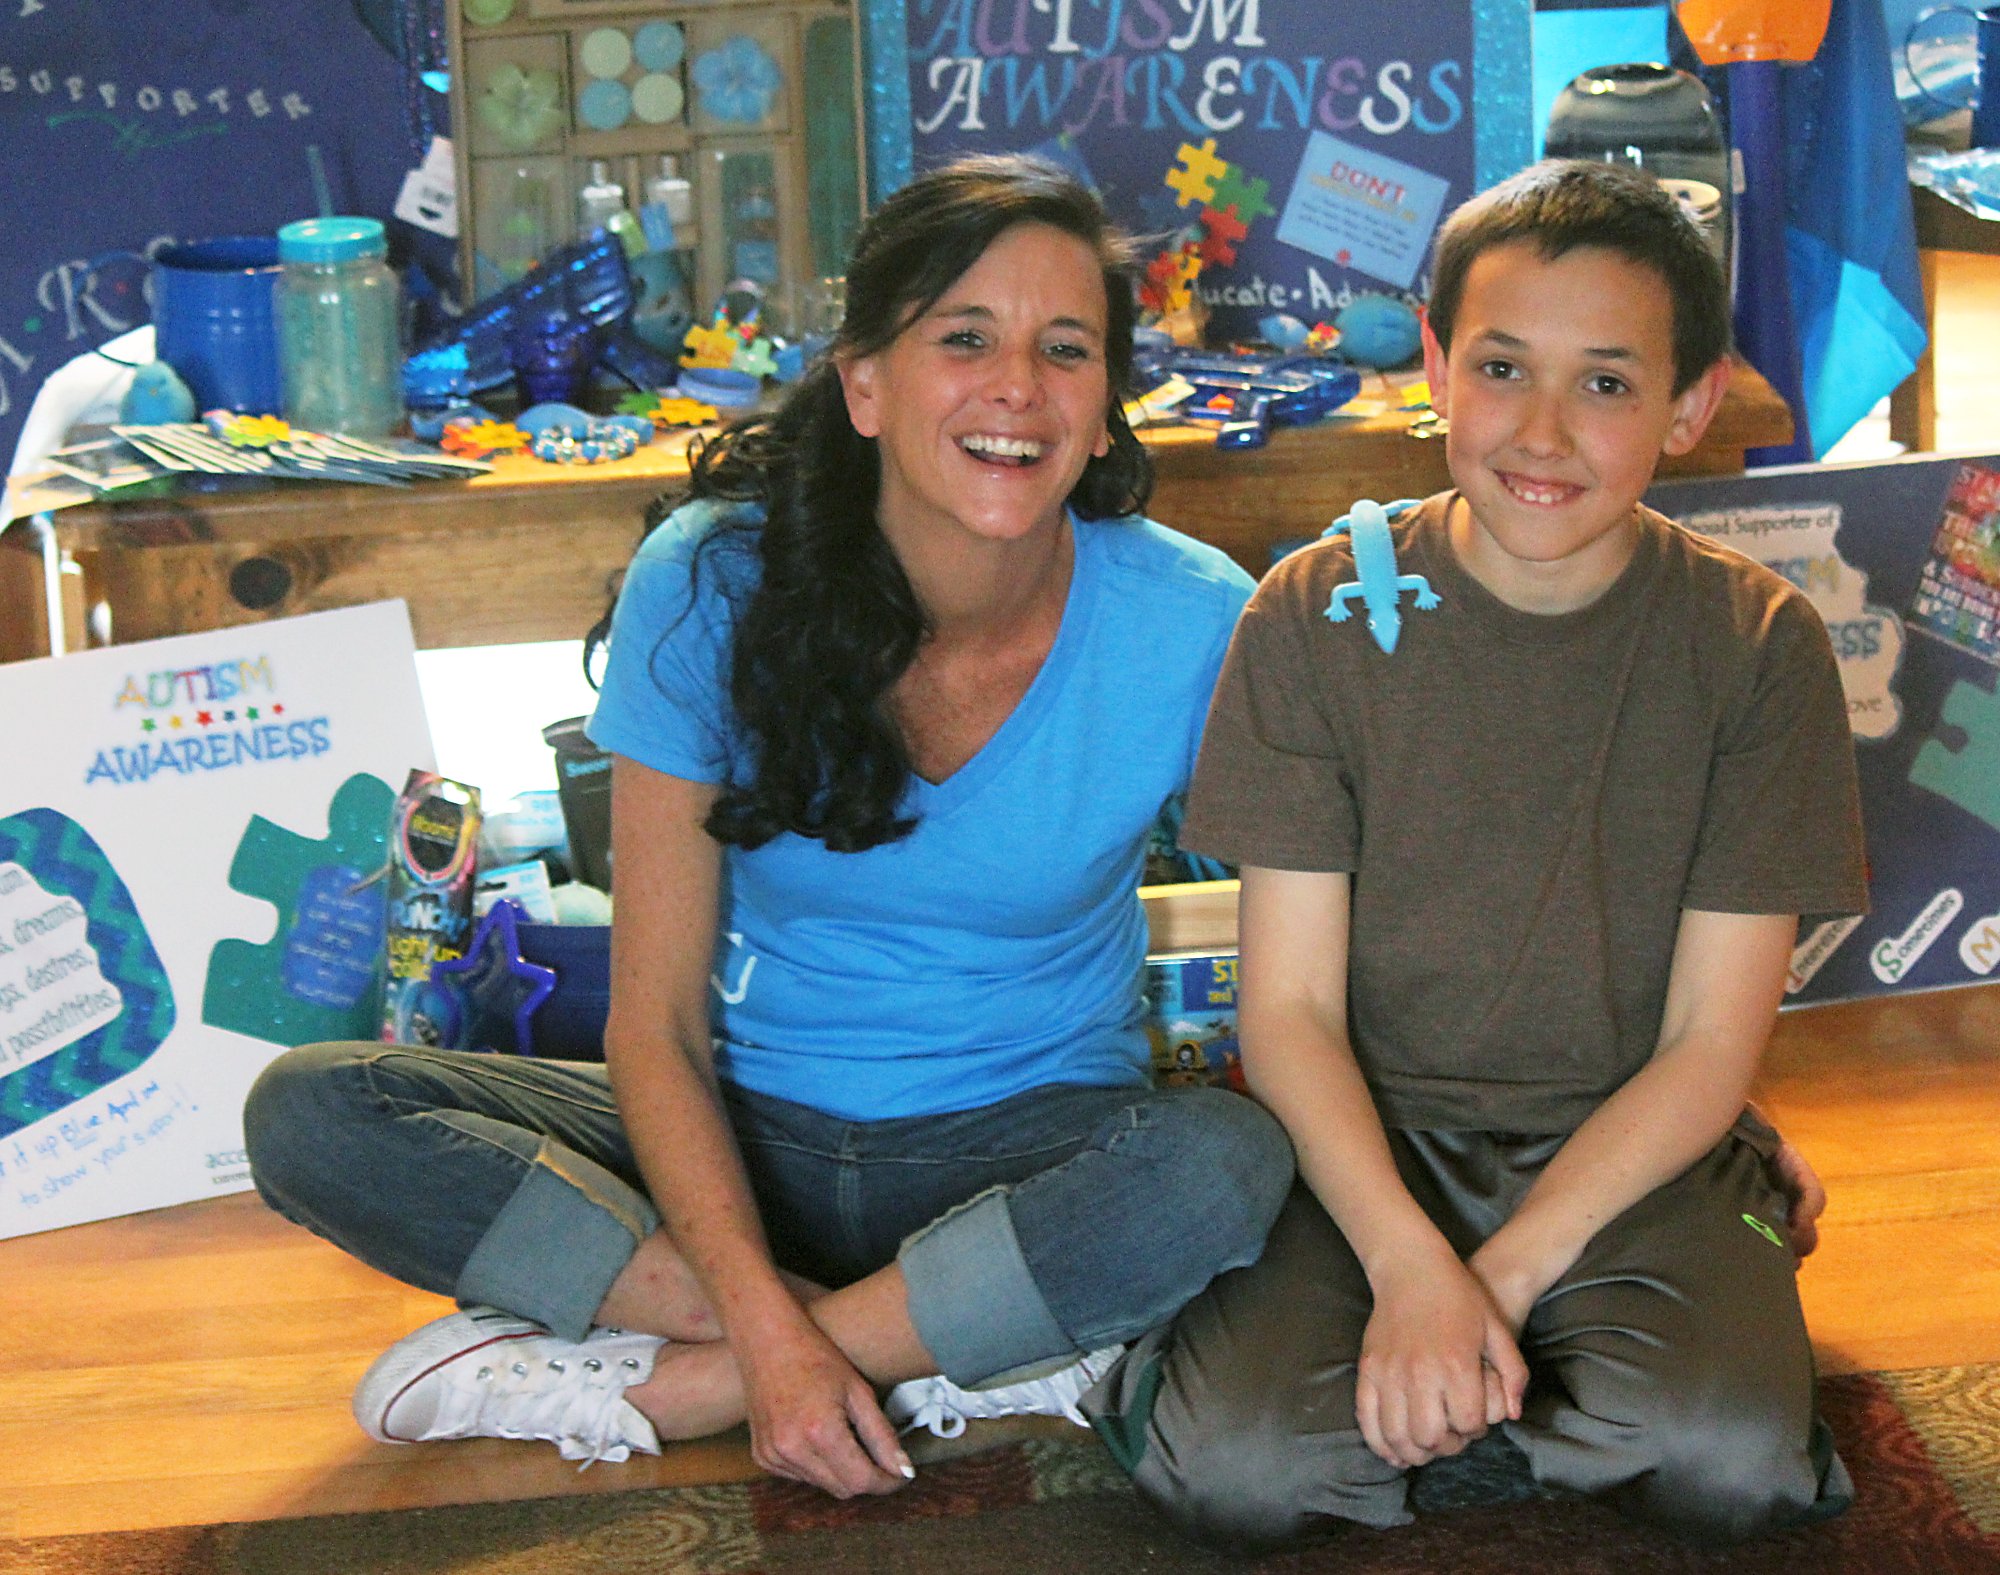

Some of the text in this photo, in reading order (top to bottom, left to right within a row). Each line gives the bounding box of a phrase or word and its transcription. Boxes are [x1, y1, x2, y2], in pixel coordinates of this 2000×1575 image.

[913, 0, 1266, 54] AUTISM
[0, 66, 311, 119] SUPPORTER
[915, 55, 1462, 136] AWARENESS
[1198, 275, 1287, 308] ucate
[115, 655, 275, 710] AUTISM
[84, 716, 331, 784] AWARENESS
